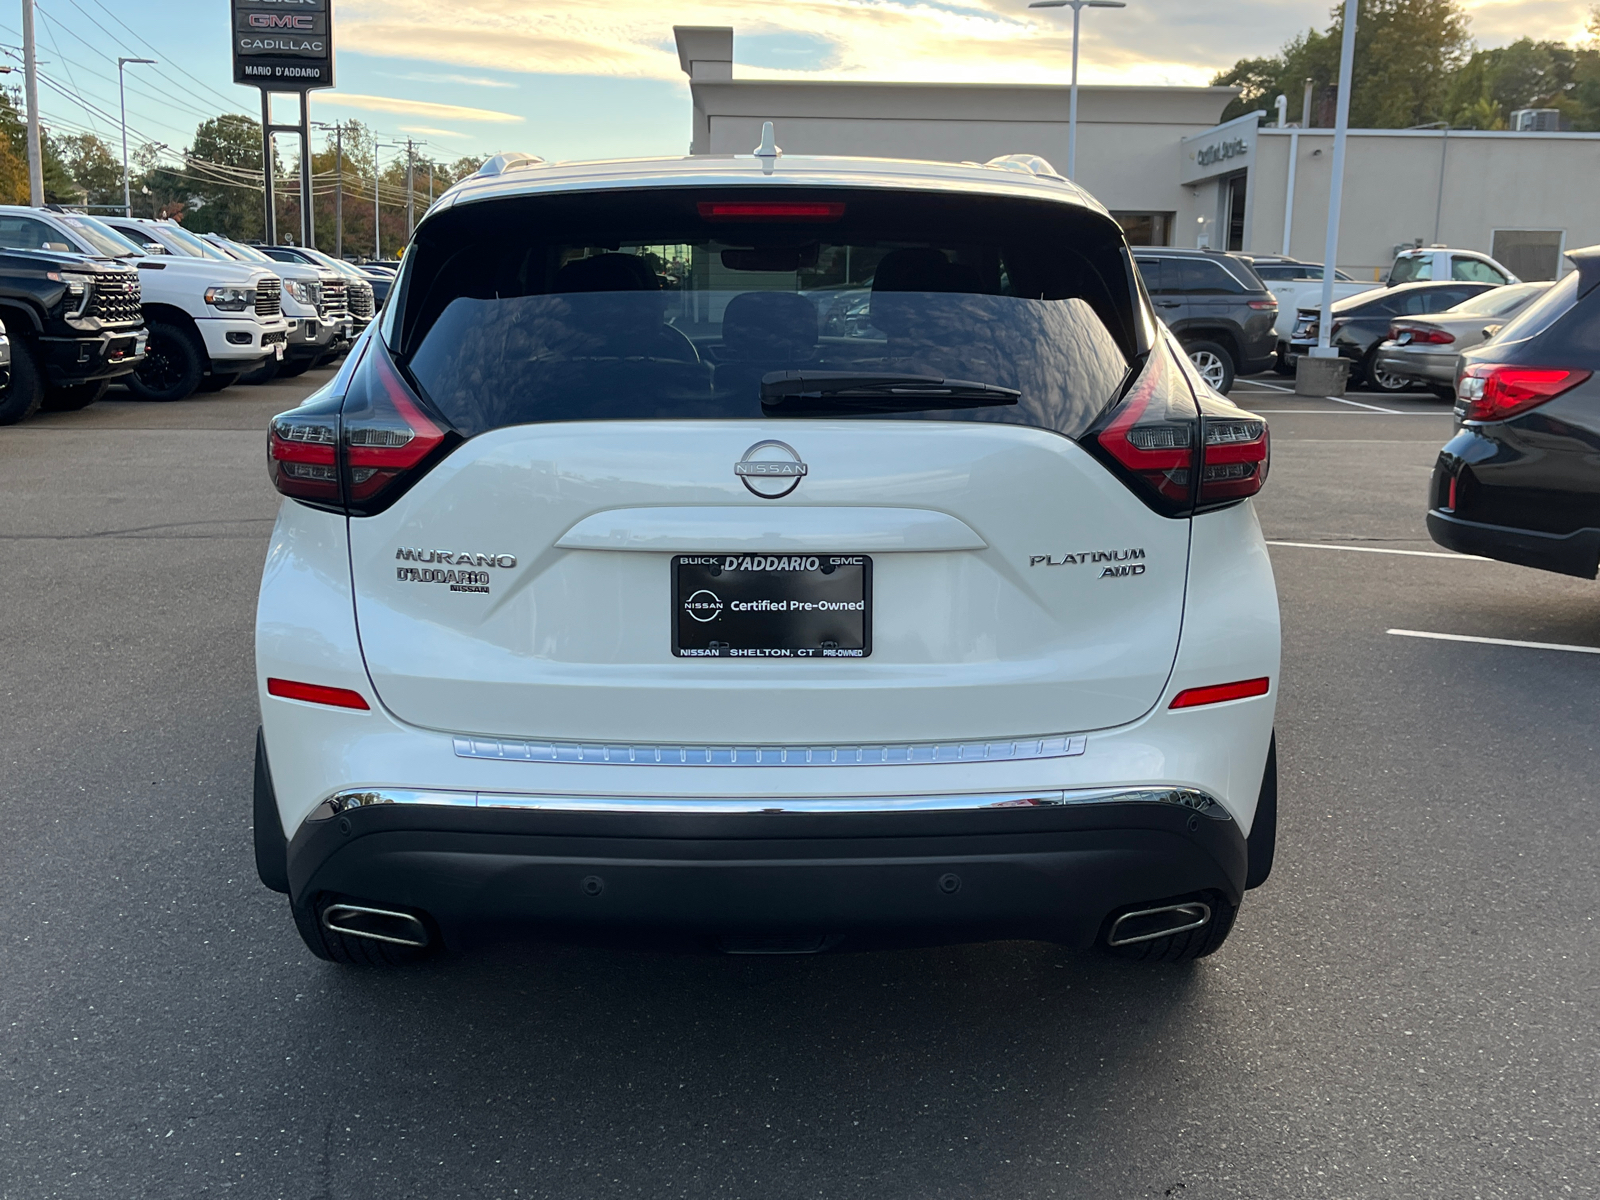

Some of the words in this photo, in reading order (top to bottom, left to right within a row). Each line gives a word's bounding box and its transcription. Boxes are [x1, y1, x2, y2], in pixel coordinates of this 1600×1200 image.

[249, 14, 313, 29] GMC
[240, 39, 323, 51] CADILLAC
[245, 66, 272, 76] MARIO
[275, 67, 320, 77] D'ADDARIO
[736, 464, 806, 474] NISSAN
[395, 546, 518, 569] MURANO
[680, 557, 719, 565] BUICK
[724, 556, 820, 571] D'ADDARIO
[829, 557, 863, 565] GMC
[1029, 547, 1146, 567] PLATINUM
[397, 567, 490, 585] D'ADDARIO
[1098, 563, 1146, 580] AWD
[450, 584, 490, 594] NISSAN
[730, 600, 787, 611] Certified
[790, 600, 865, 611] Pre-Owned
[729, 649, 794, 658] SHELTON,
